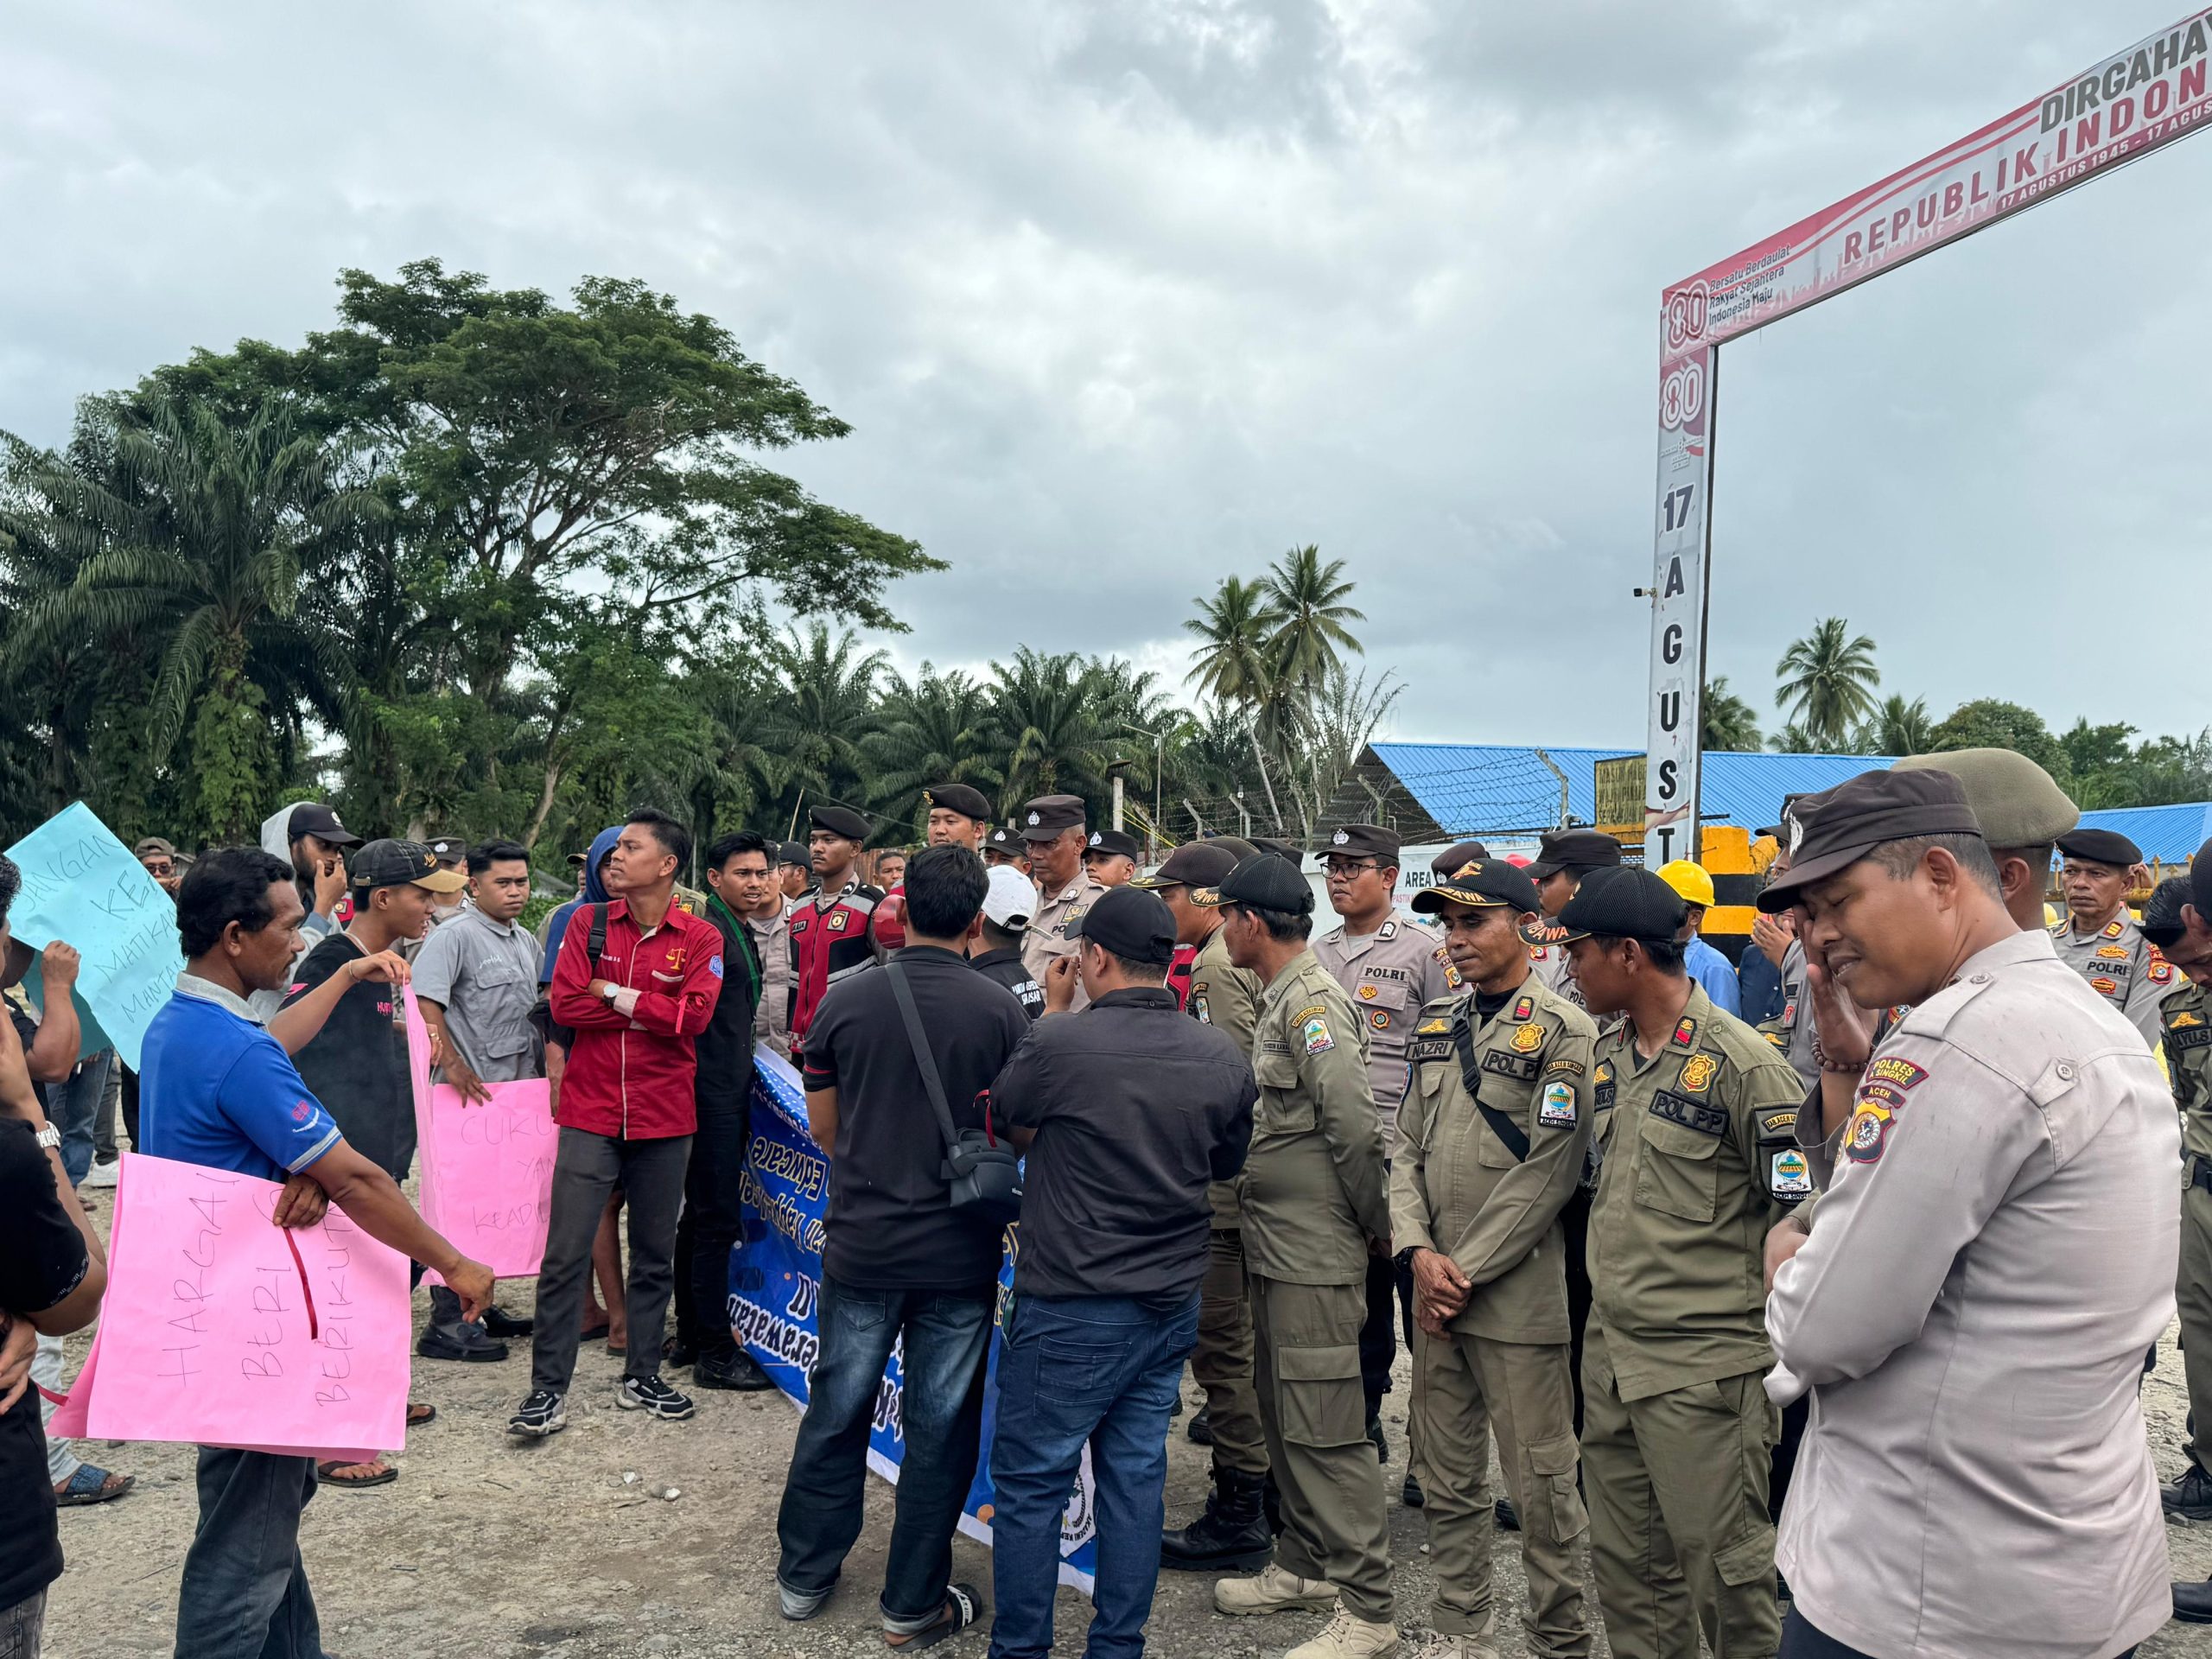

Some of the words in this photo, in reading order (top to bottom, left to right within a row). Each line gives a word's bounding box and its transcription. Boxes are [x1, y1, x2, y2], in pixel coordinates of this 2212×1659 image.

[1844, 141, 2039, 265] REPUBLIK
[2056, 57, 2207, 164] INDON
[2000, 195, 2016, 209] 17
[2018, 161, 2087, 202] AGUSTUS
[2091, 141, 2129, 168] 1945
[2147, 123, 2164, 142] 17
[1709, 269, 1744, 293] Bersatu
[1745, 244, 1790, 276] Berdaulat
[1709, 288, 1738, 310] Rakyat
[1740, 266, 1785, 293] Sejahtera
[1668, 278, 1708, 350] 80
[1708, 298, 1751, 326] Indonesia
[1752, 288, 1773, 306] Maju
[1662, 361, 1703, 430] 80
[1663, 484, 1694, 531] 17
[22, 835, 122, 912] JANGAN
[1405, 871, 1432, 888] AREA
[1364, 967, 1406, 981] POLRI
[2087, 961, 2127, 976] POLRI
[1412, 1042, 1448, 1058] NAZRI
[1488, 1052, 1517, 1074] POL
[1873, 1059, 1916, 1077] POLRES
[1868, 1088, 1891, 1098] ACEH
[1876, 1069, 1909, 1084] SINGKIL
[1655, 1093, 1687, 1121] POL
[1692, 1109, 1723, 1129] PP
[751, 1136, 826, 1202] Edwcare
[241, 1267, 291, 1381] BERI
